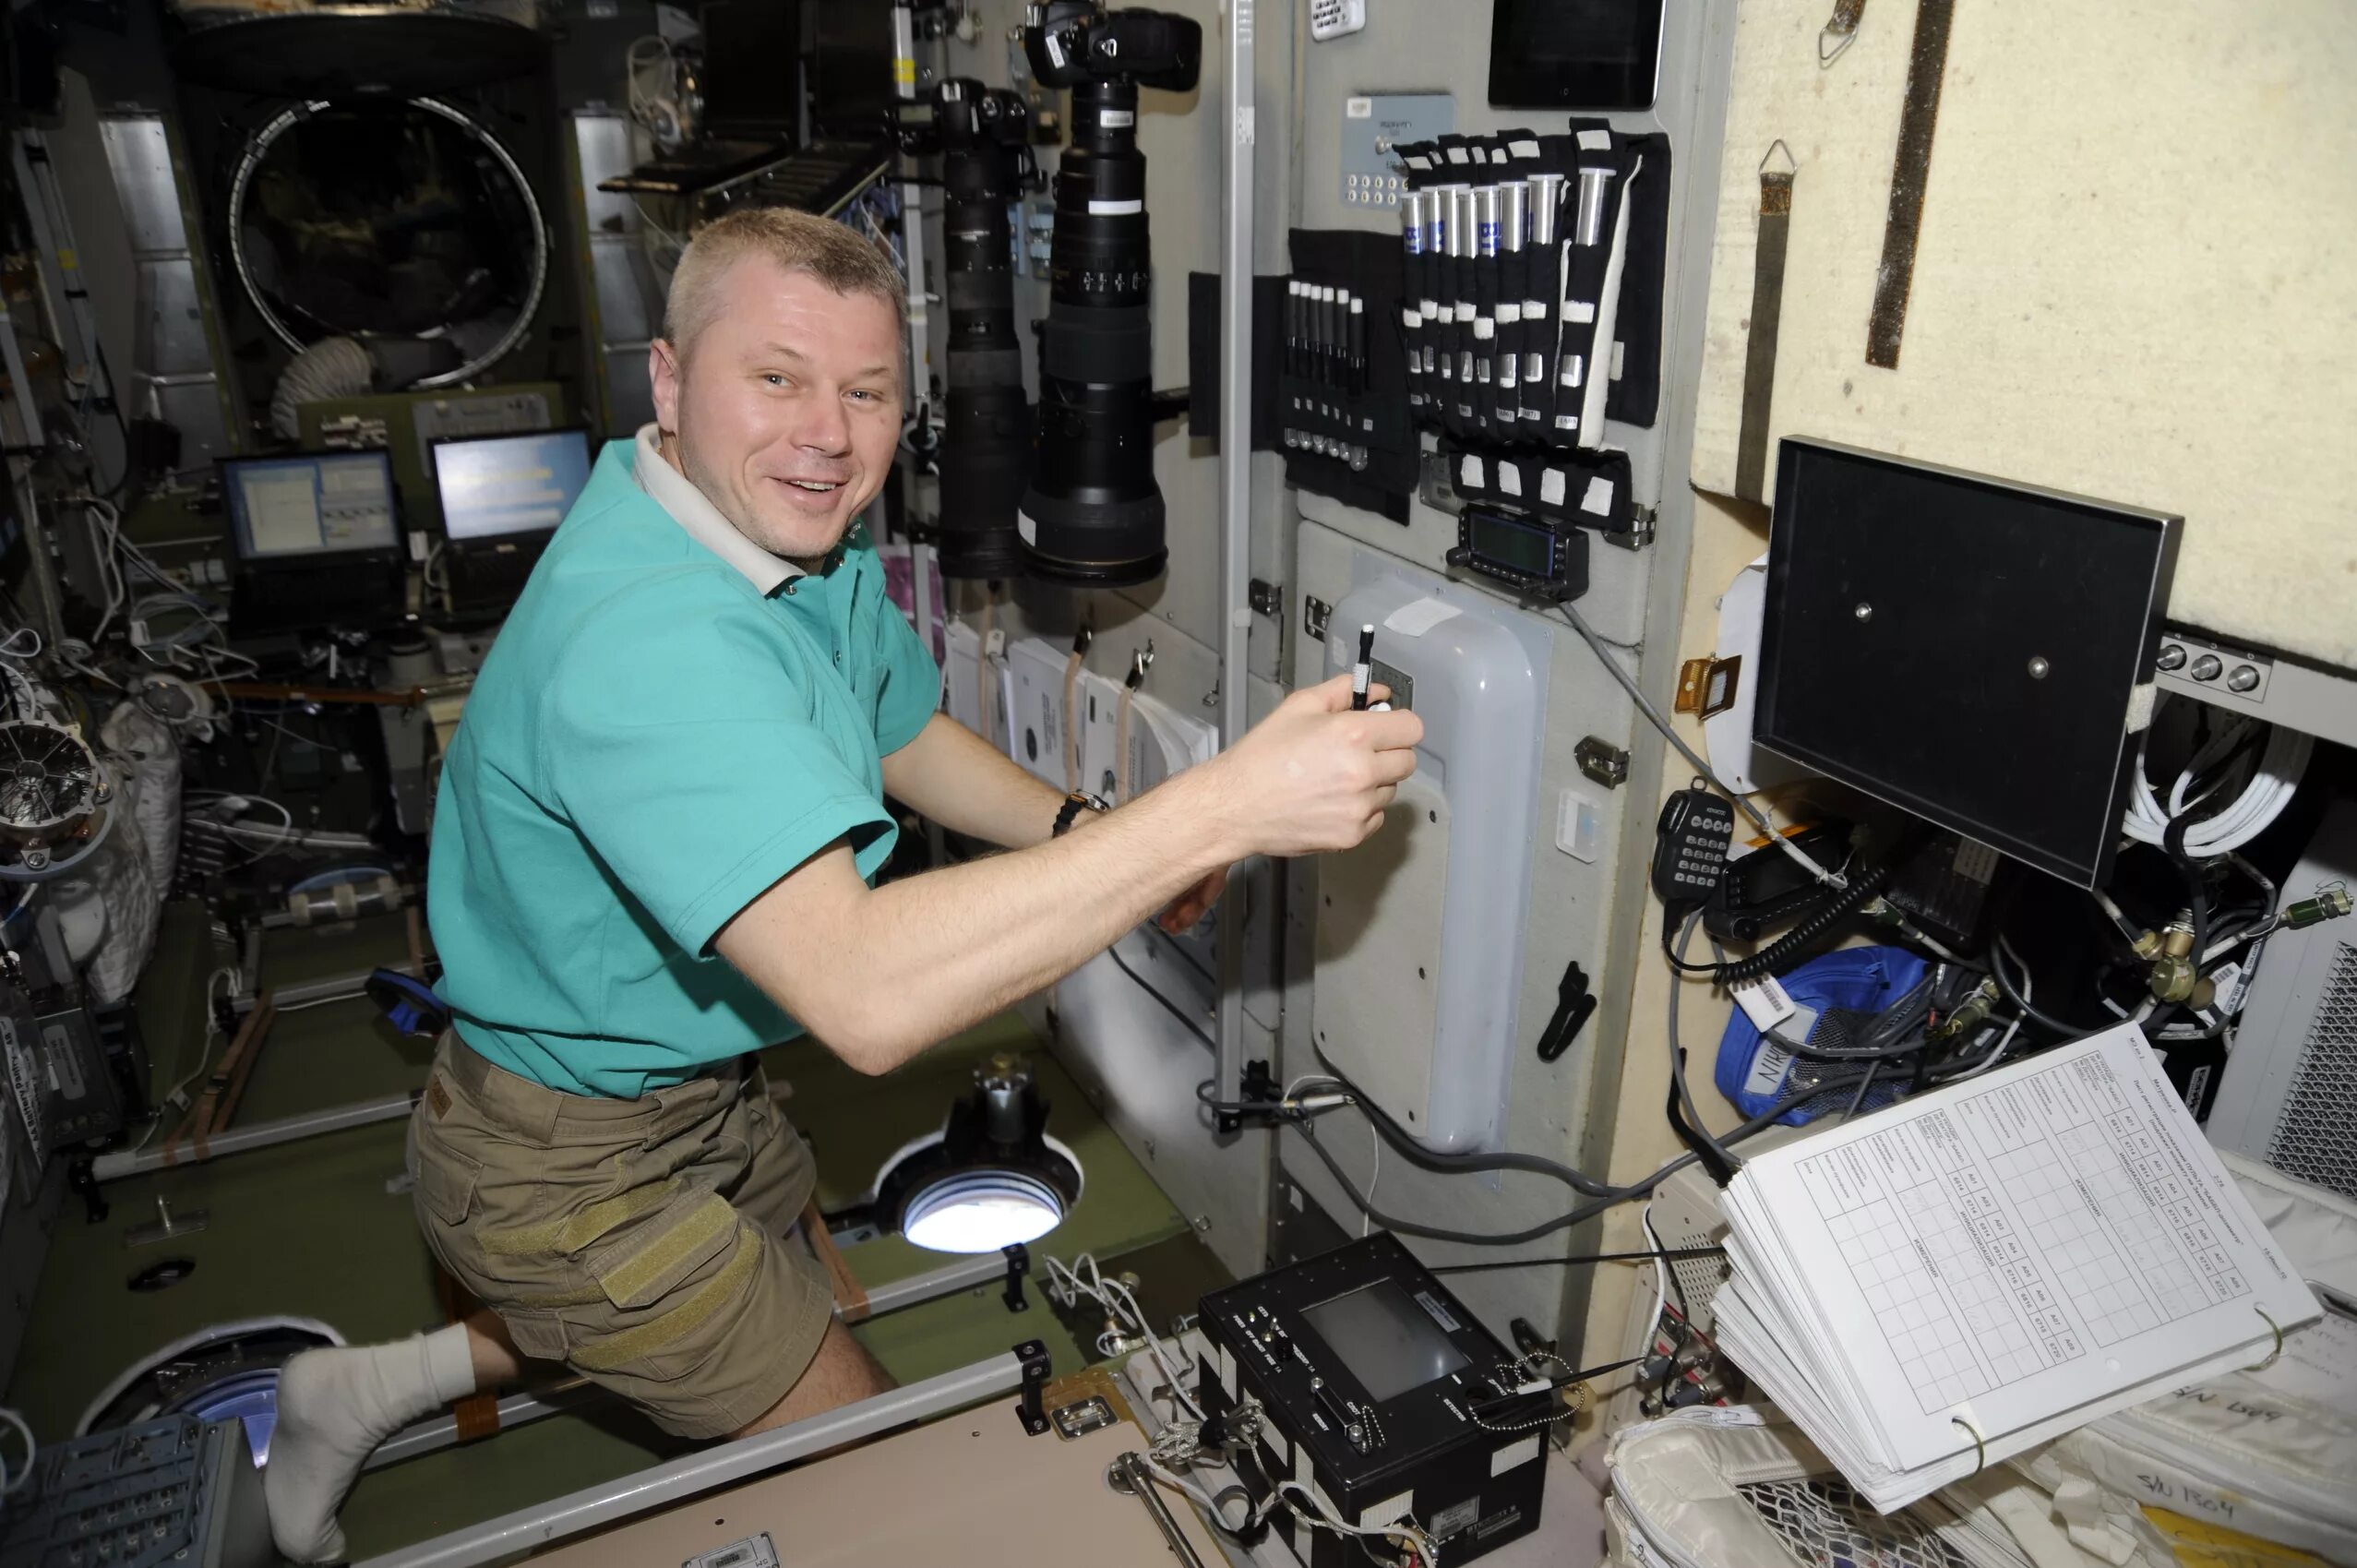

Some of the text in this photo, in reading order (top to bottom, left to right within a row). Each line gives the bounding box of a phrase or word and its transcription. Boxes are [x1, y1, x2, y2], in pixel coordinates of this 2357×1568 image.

[11, 1055, 24, 1090] Pantry
[18, 1090, 36, 1128] Battery
[2141, 1095, 2168, 1131] регистрации
[2184, 1162, 2204, 1187] ПУЛЬТА
[2074, 1178, 2101, 1217] ИЗМЕРЕНИЯ
[2117, 1151, 2156, 1207] ИНИЦИАЛИЗАЦИЯ
[1958, 1210, 1995, 1267] ИНИЦИАЛИЗАЦИЯ
[1912, 1238, 1939, 1278] ИЗМЕРЕНИЯ
[1264, 1353, 1276, 1367] FUSE
[1442, 1397, 1466, 1422] DETECTOR
[2136, 1474, 2173, 1499] S/N
